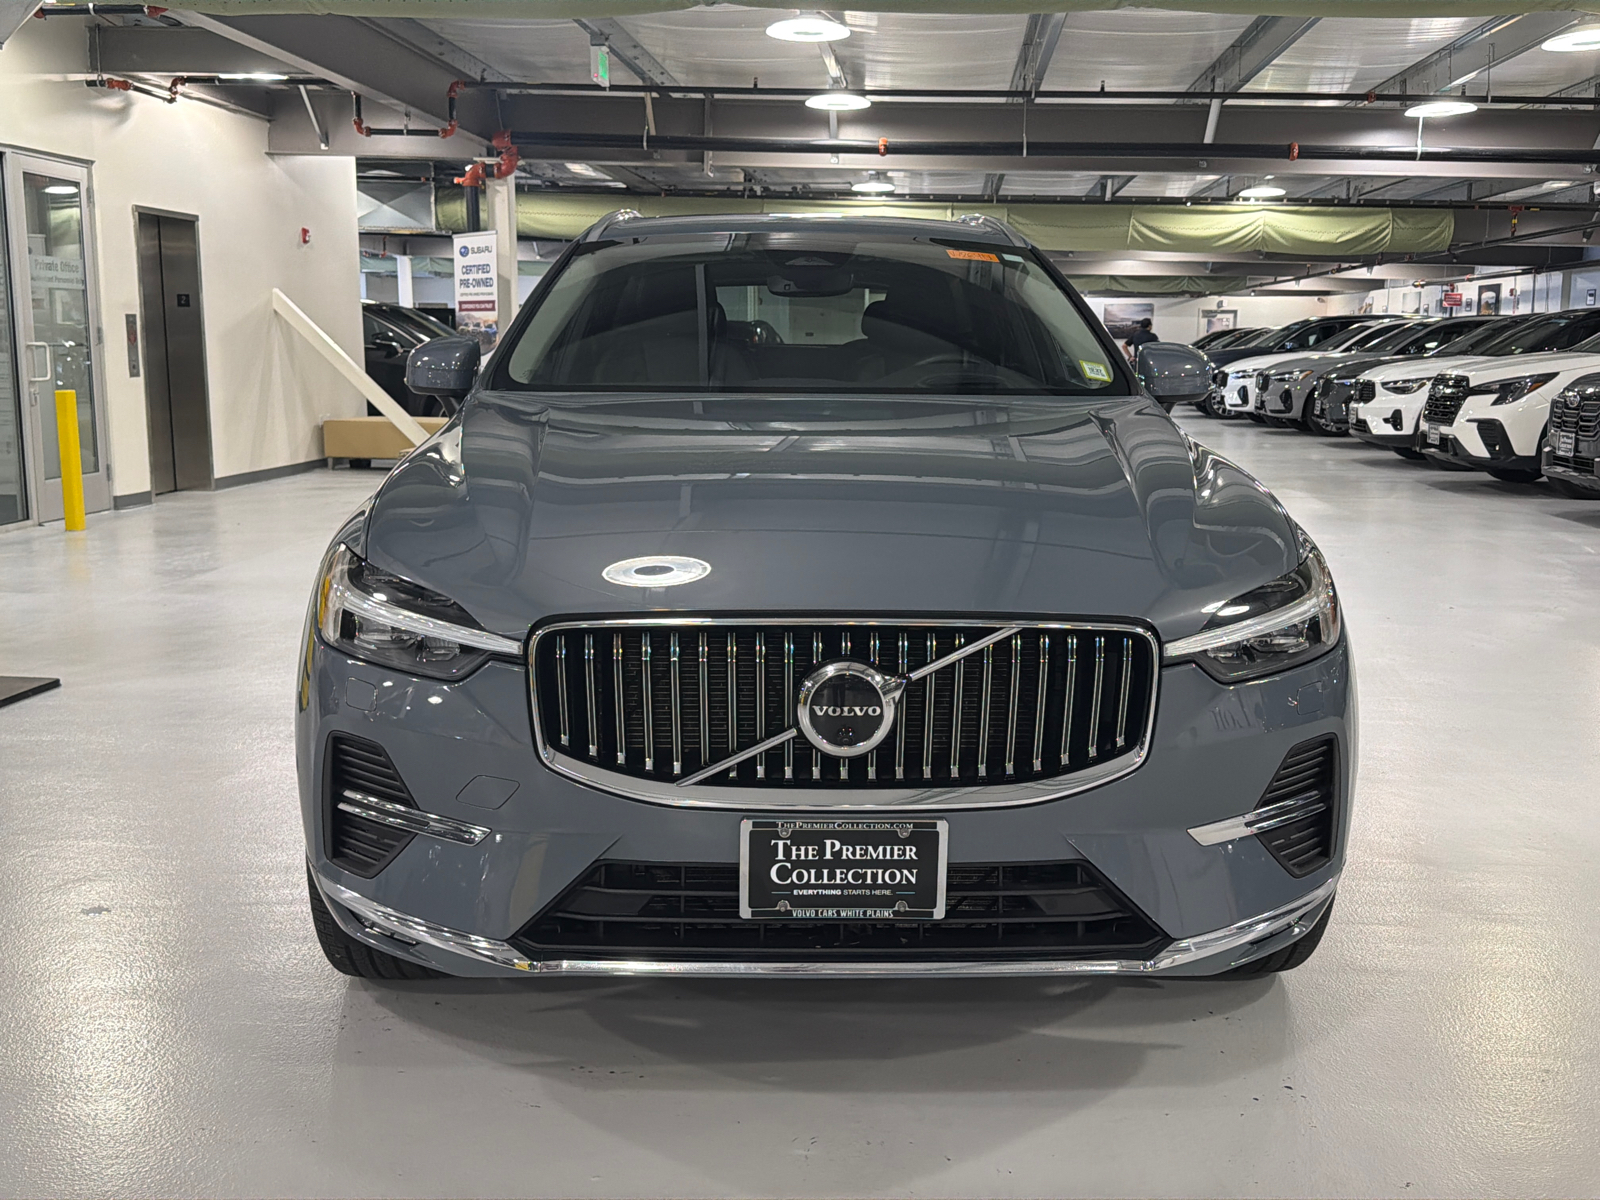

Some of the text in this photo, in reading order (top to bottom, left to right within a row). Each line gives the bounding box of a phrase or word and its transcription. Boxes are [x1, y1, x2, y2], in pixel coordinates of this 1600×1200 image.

[470, 246, 492, 254] SUBARU
[35, 259, 80, 274] Private Office
[461, 264, 491, 275] CERTIFIED
[459, 277, 494, 289] PRE-OWNED
[812, 705, 881, 717] VOLVO
[770, 839, 919, 861] THE PREMIER
[769, 862, 918, 885] COLLECTION
[792, 909, 894, 918] VOLVO CARS WHITE PLAINS
